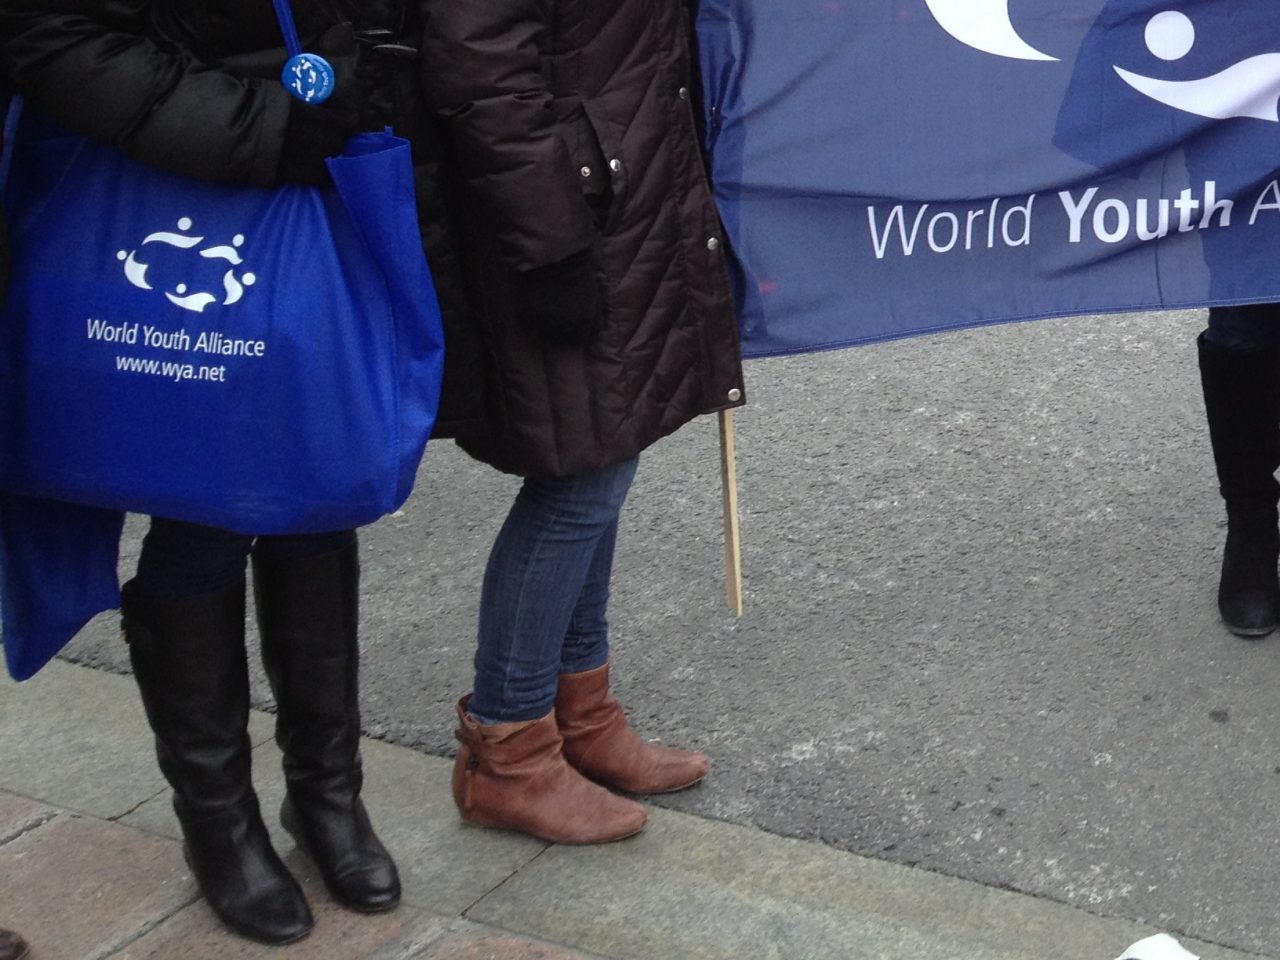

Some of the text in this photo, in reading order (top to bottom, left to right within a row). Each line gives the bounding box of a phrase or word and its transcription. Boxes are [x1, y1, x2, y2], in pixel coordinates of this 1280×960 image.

[866, 194, 1036, 260] World
[1057, 180, 1233, 243] Youth
[87, 318, 266, 357] World Youth Alliance
[115, 356, 227, 383] www.wya.net
